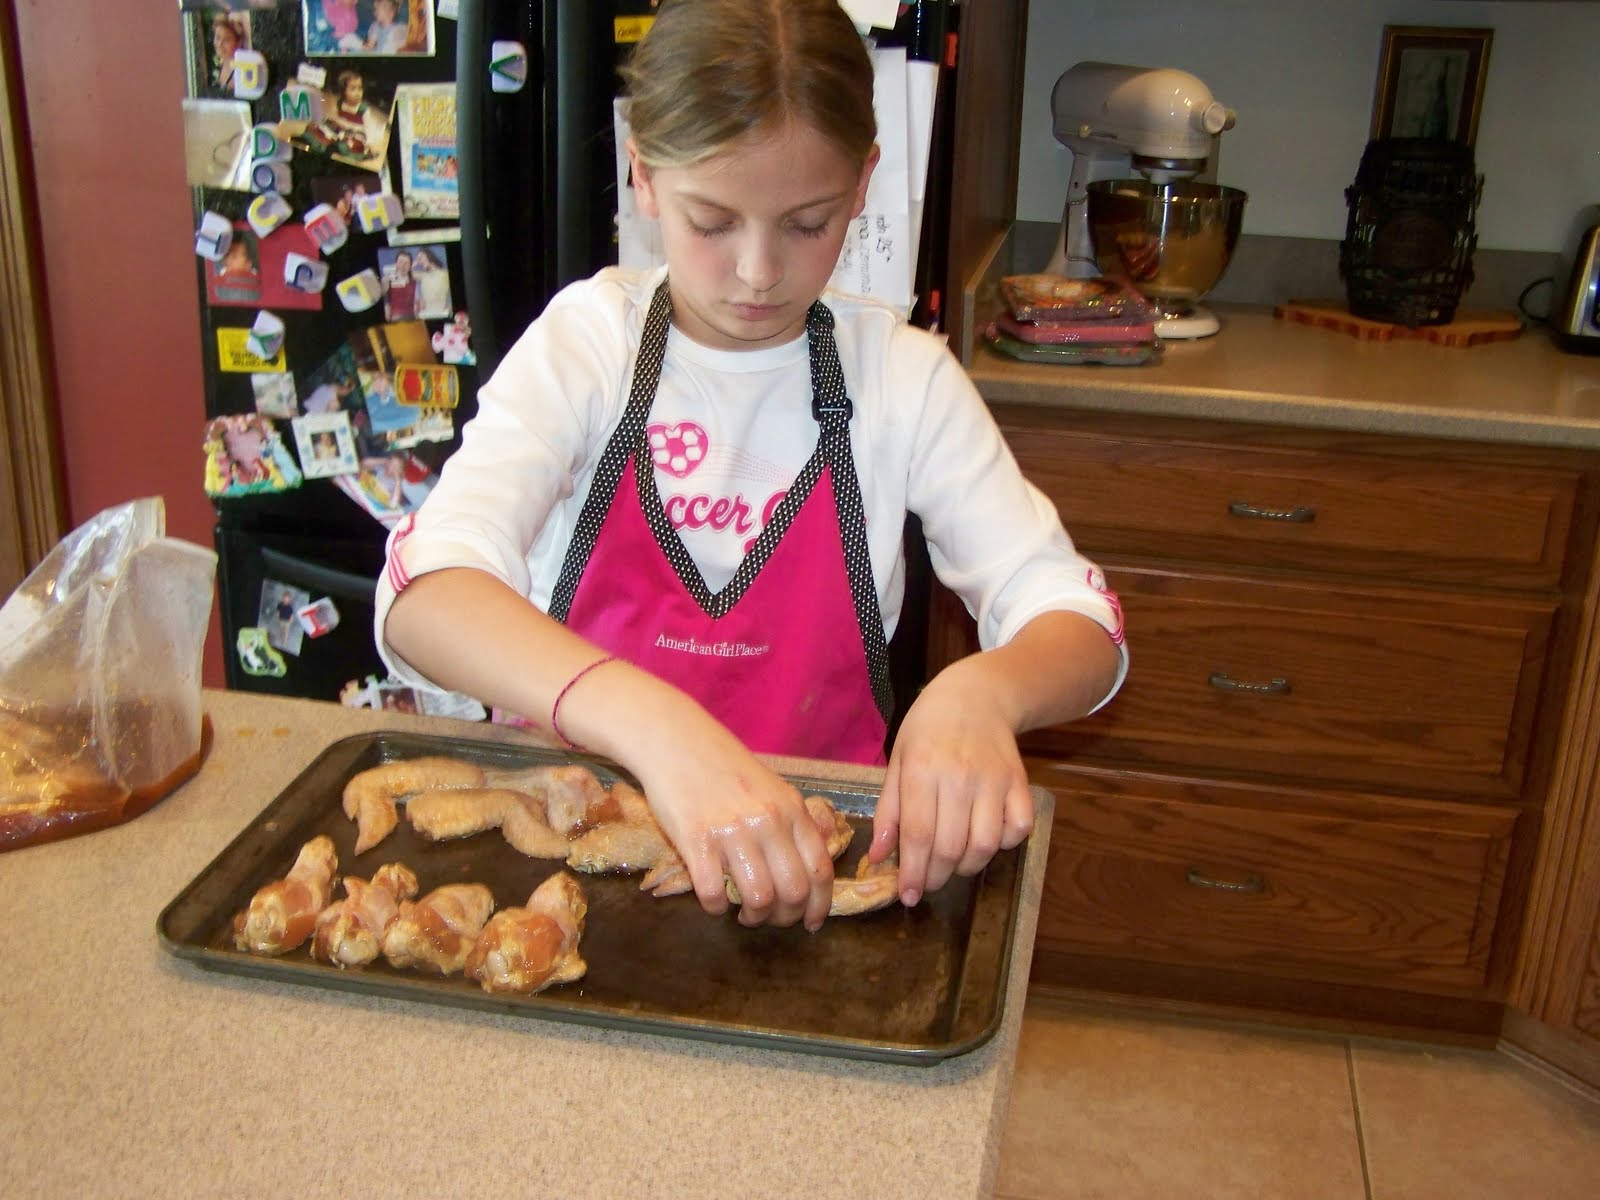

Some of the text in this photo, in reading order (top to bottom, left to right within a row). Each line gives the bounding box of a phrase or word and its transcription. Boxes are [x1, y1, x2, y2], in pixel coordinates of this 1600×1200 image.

[280, 91, 311, 122] M
[254, 128, 276, 158] D
[249, 195, 278, 227] C
[361, 196, 389, 232] H
[305, 214, 337, 248] E
[655, 632, 712, 656] American
[713, 642, 735, 657] Girl
